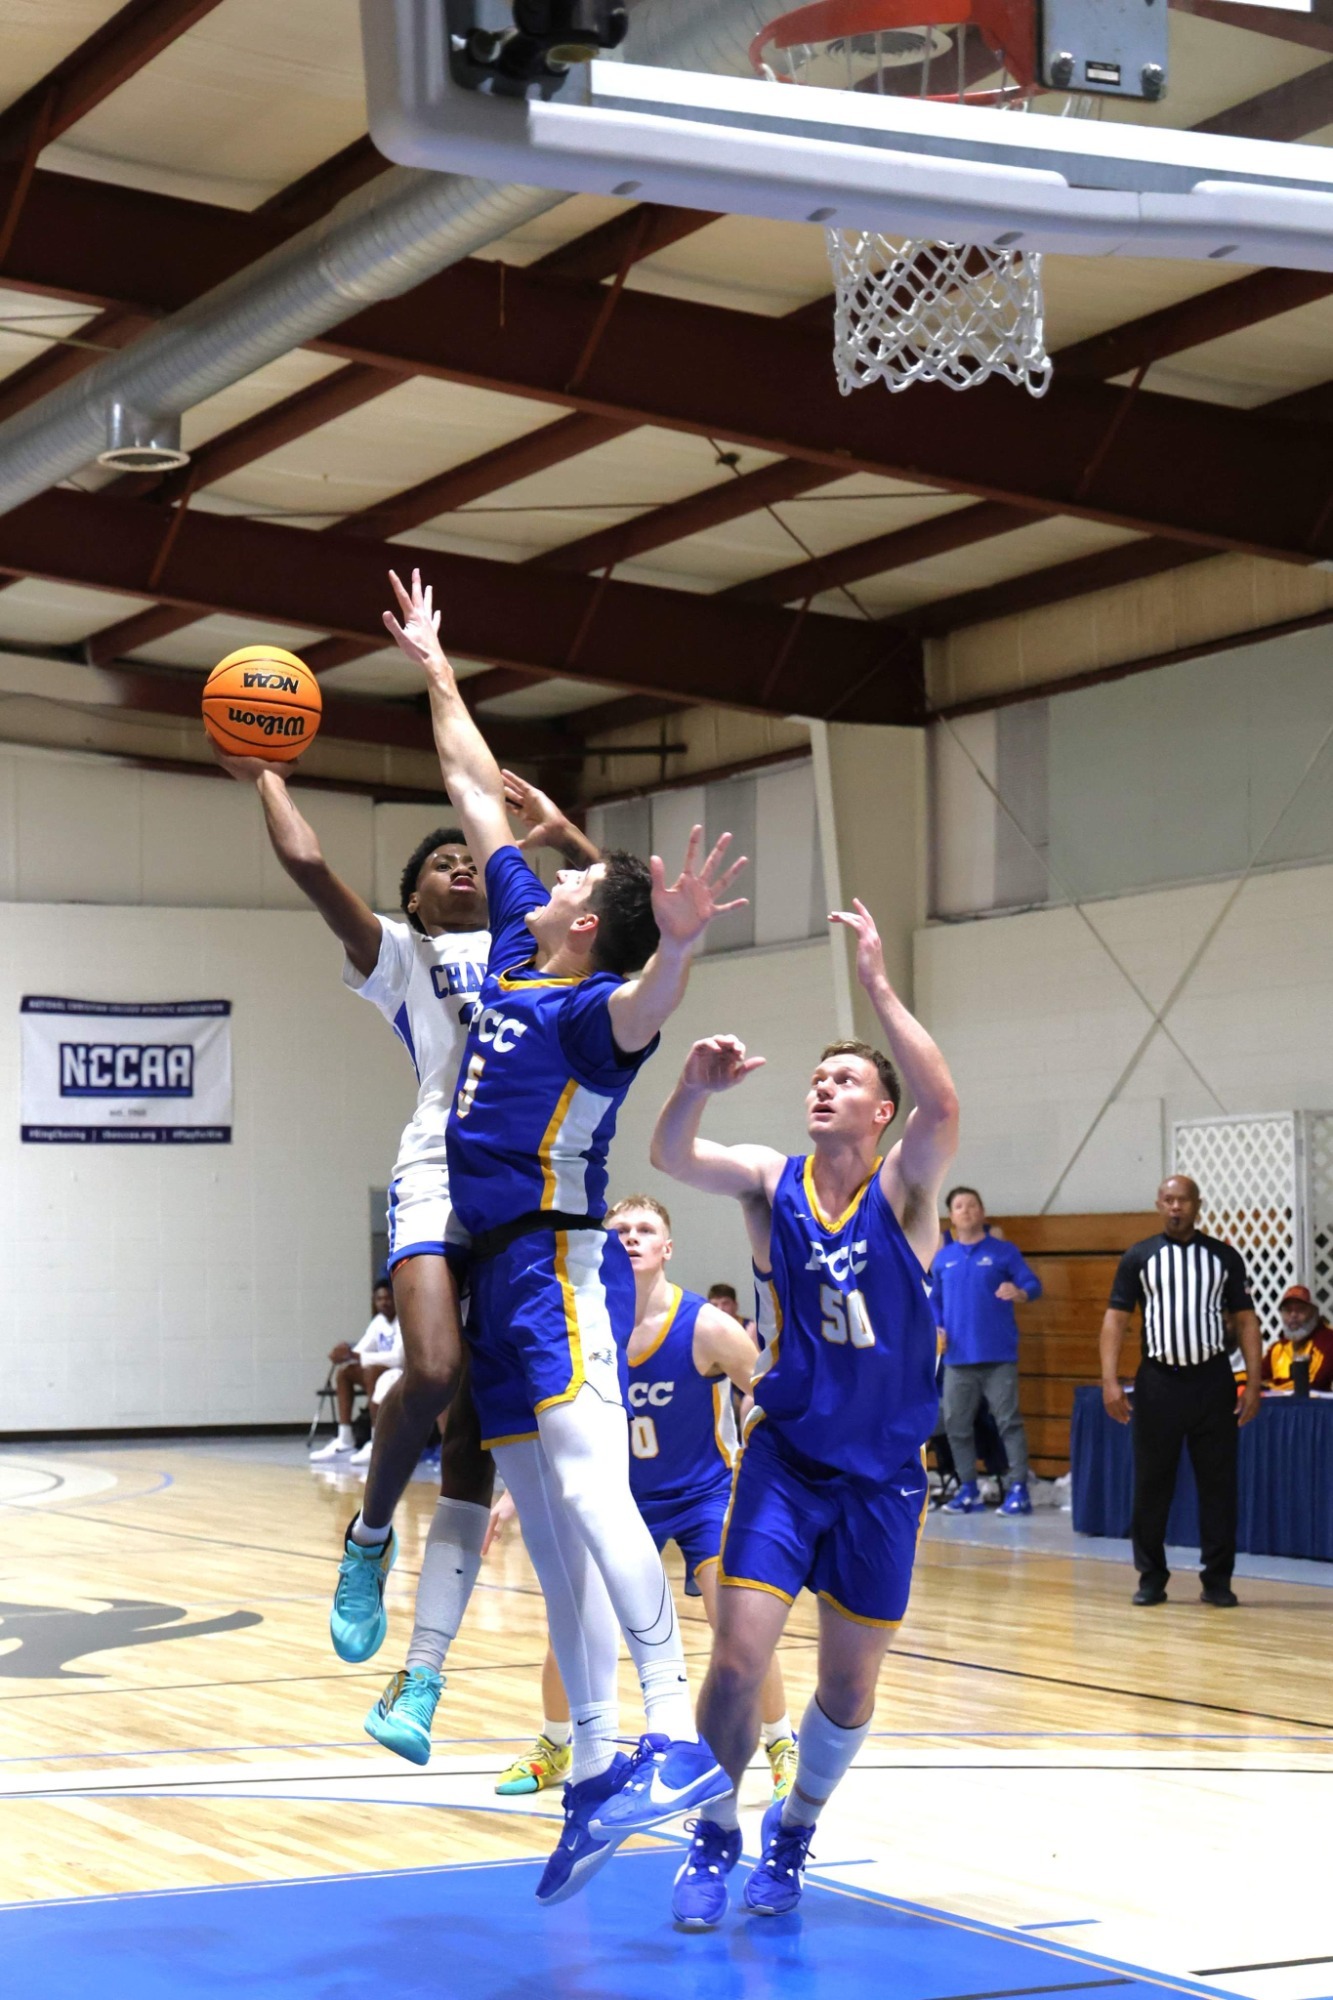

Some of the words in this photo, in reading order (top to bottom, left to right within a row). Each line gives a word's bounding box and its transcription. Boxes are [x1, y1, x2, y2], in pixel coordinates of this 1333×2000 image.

[243, 672, 299, 695] NCAA
[228, 707, 305, 736] Wilson
[61, 1043, 193, 1089] NCCAA
[804, 1239, 868, 1282] PCC
[820, 1283, 876, 1349] 50
[628, 1381, 675, 1408] CC
